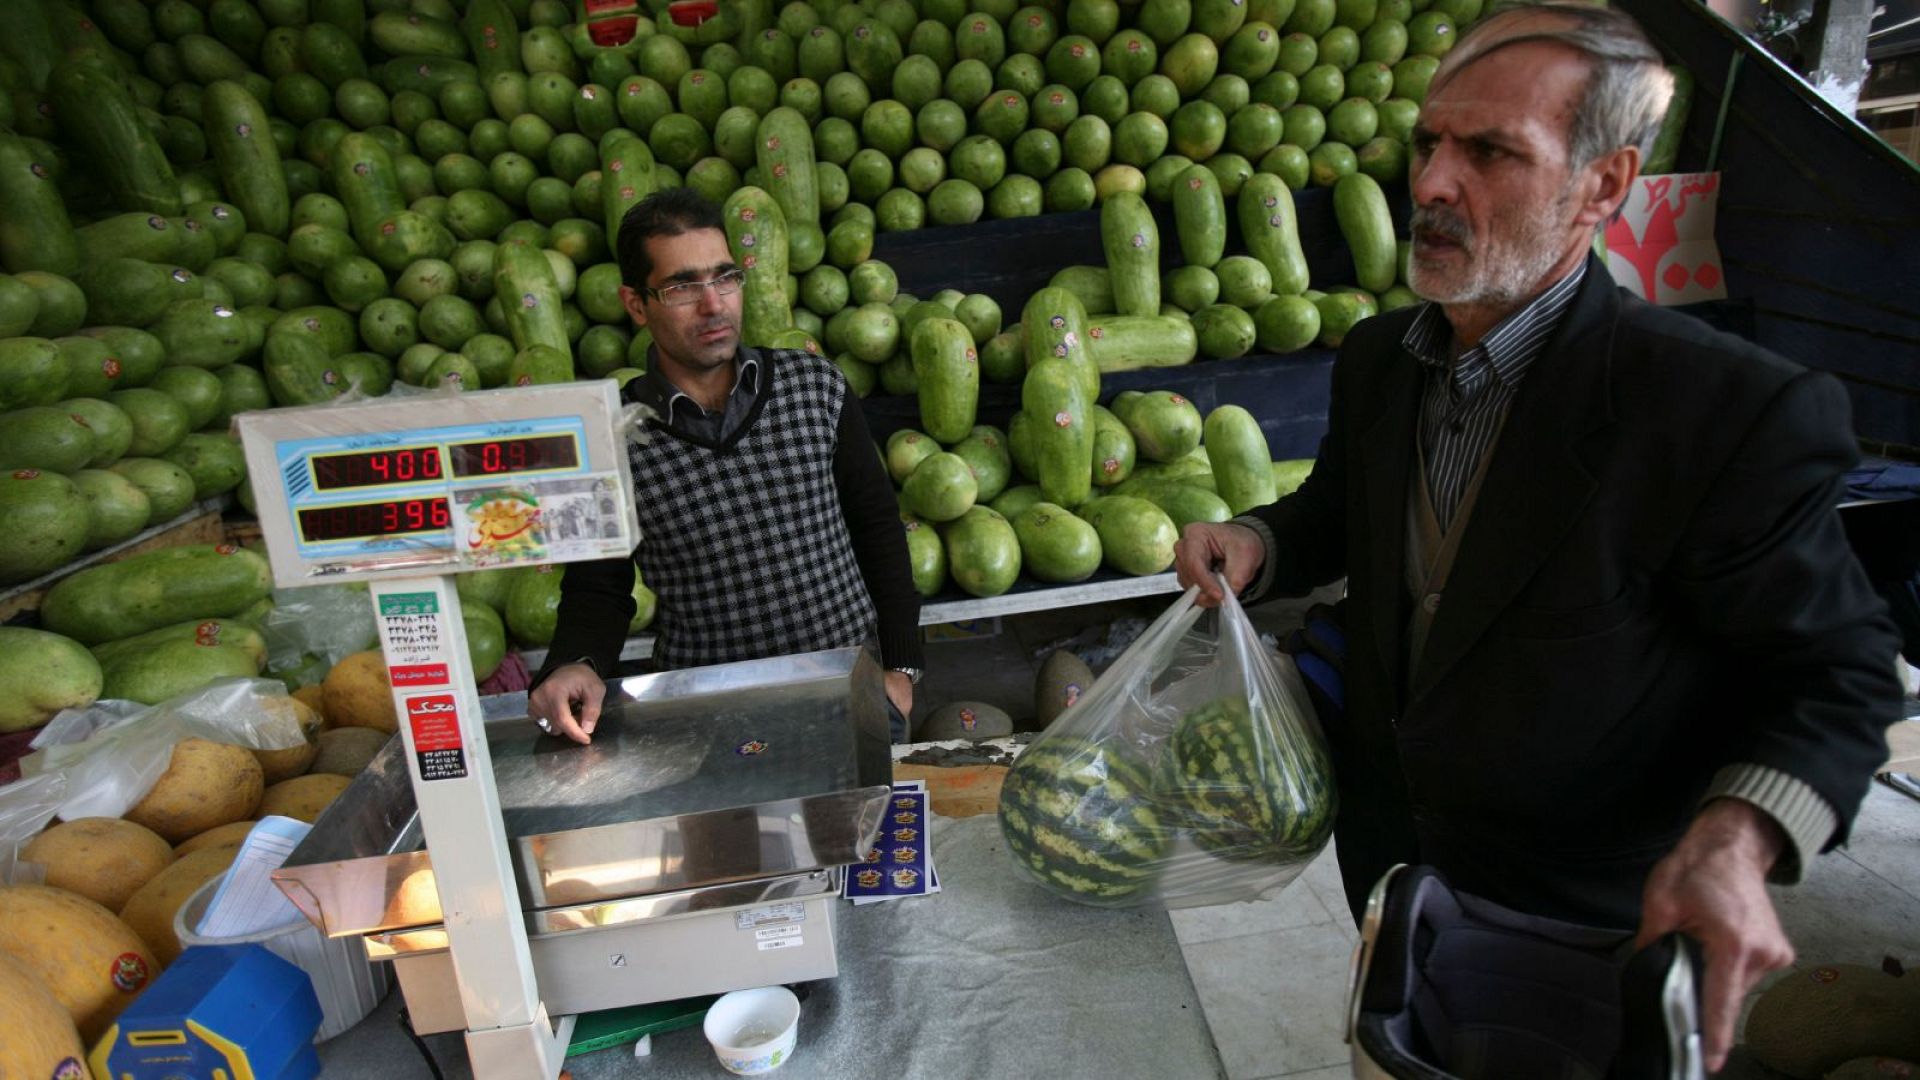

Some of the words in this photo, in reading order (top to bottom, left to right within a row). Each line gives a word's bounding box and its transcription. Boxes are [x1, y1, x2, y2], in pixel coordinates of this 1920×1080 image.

[371, 448, 441, 481] 400
[383, 497, 450, 531] 396
[410, 701, 456, 715] محک
